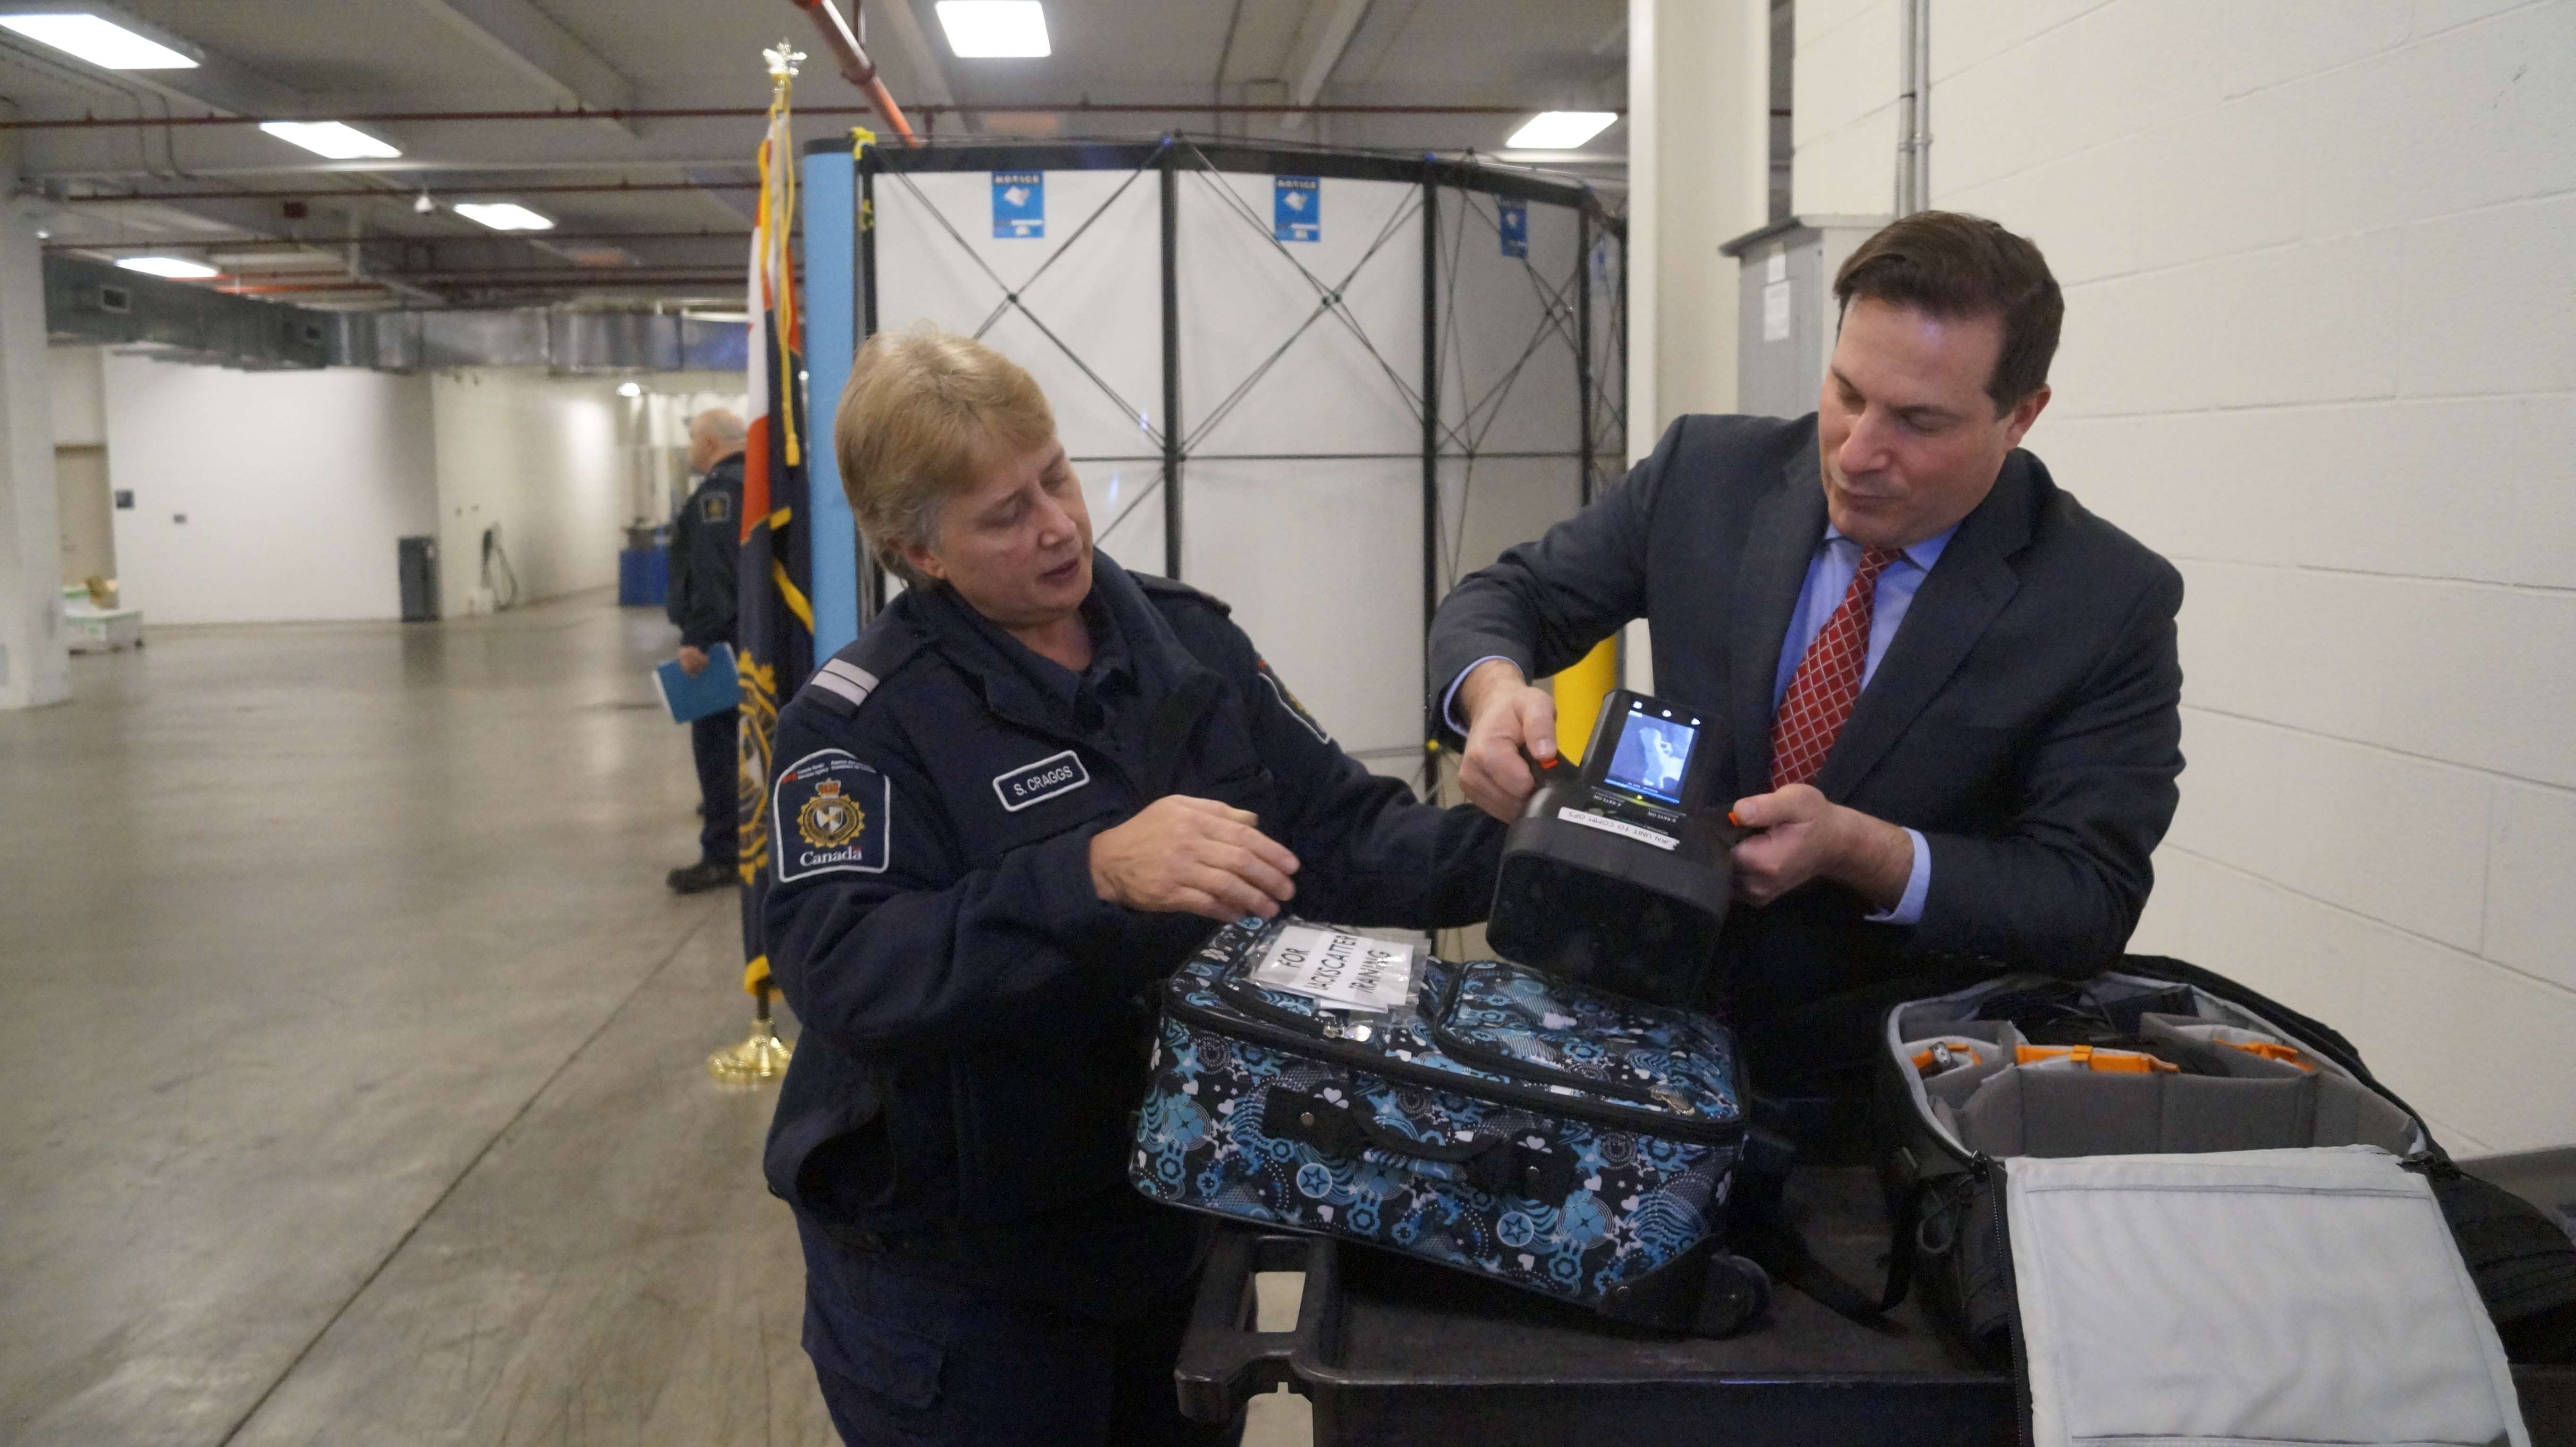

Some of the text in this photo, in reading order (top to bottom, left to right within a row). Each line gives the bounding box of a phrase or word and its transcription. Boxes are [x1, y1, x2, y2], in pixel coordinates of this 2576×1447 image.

[1014, 766, 1073, 796] S. CRAGGS
[1568, 811, 1585, 820] OPS
[1588, 817, 1614, 827] COMM
[1633, 830, 1652, 840] UNIT
[800, 845, 862, 867] Canada
[1278, 947, 1310, 968] FOR
